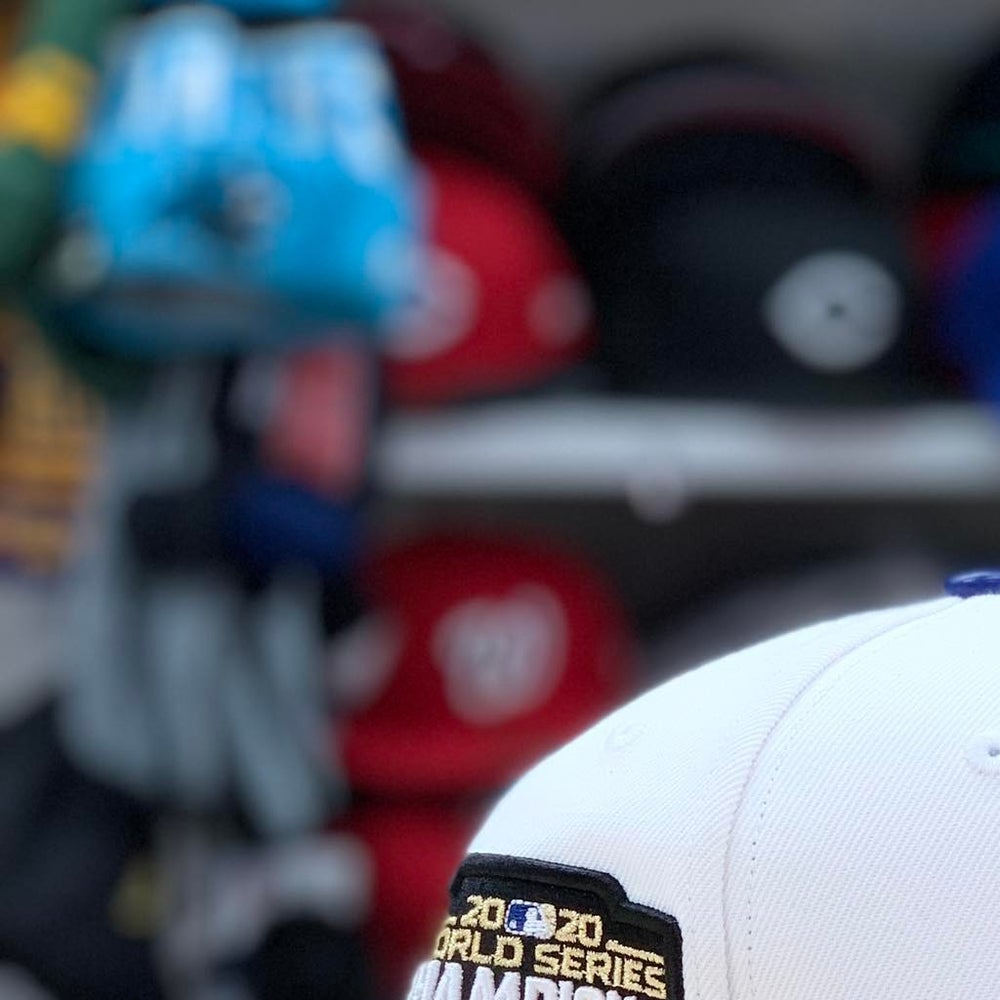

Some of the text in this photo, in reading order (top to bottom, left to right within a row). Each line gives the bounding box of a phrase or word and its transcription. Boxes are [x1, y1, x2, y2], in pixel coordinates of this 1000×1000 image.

[460, 895, 602, 948] 20 20
[433, 927, 667, 1000] ORLD SERIES
